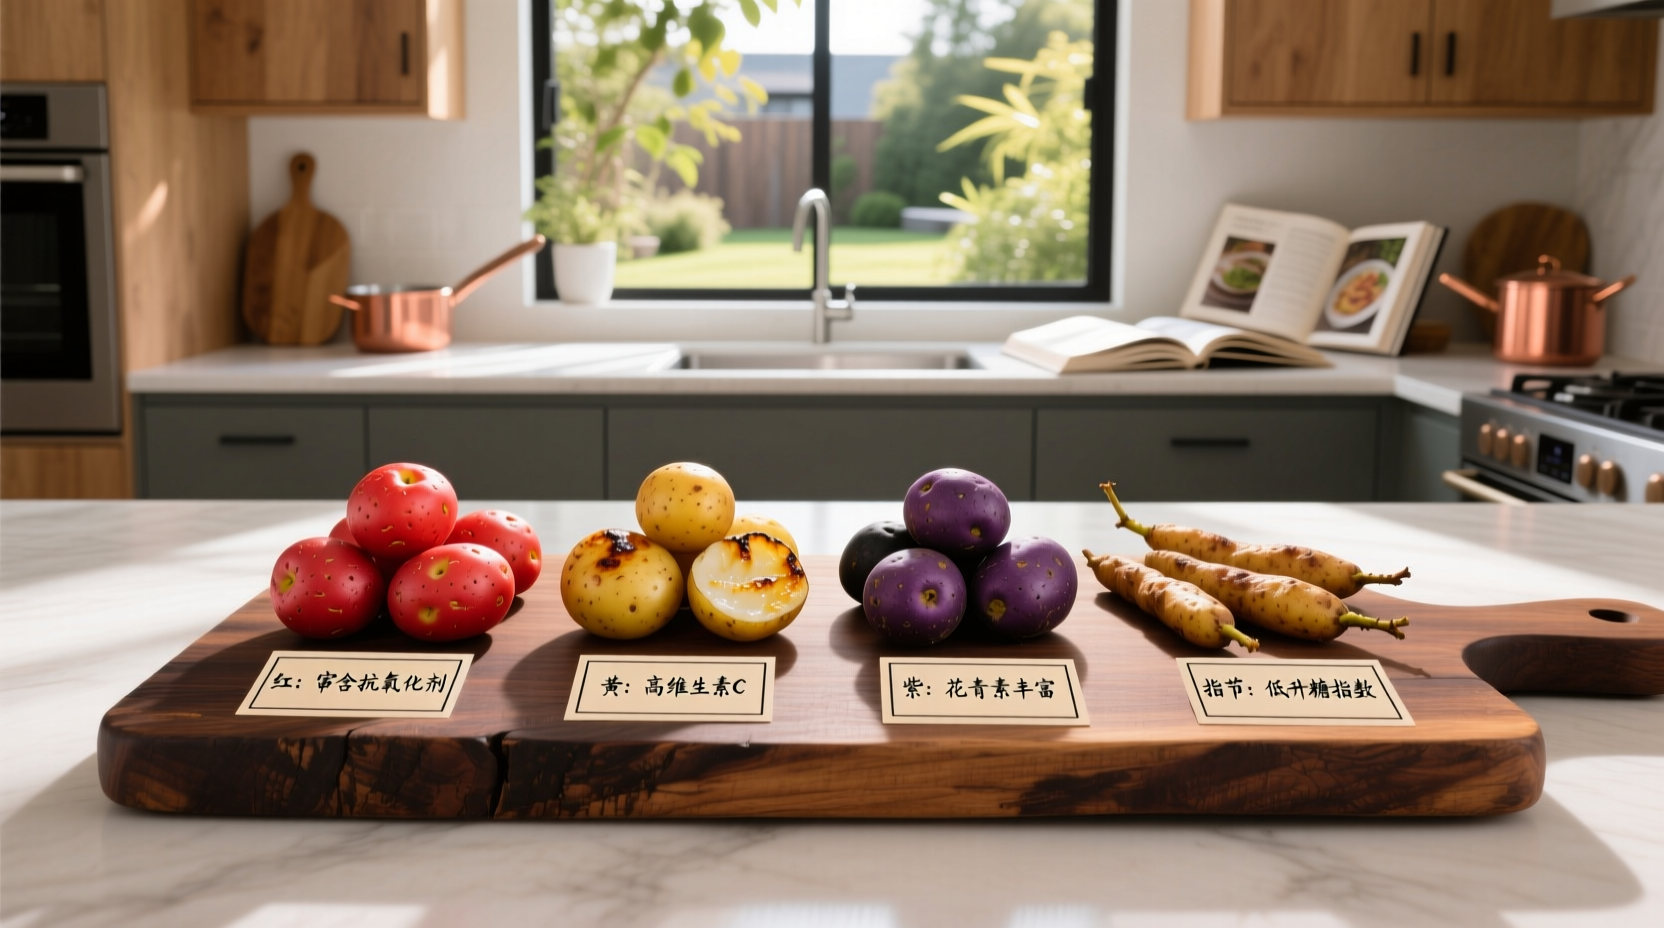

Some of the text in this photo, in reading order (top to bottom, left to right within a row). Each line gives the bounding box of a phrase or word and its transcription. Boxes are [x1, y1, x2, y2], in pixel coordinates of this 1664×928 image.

[600, 674, 747, 697] 黄：高维生素C
[902, 676, 1055, 699] 紫：花青素丰富
